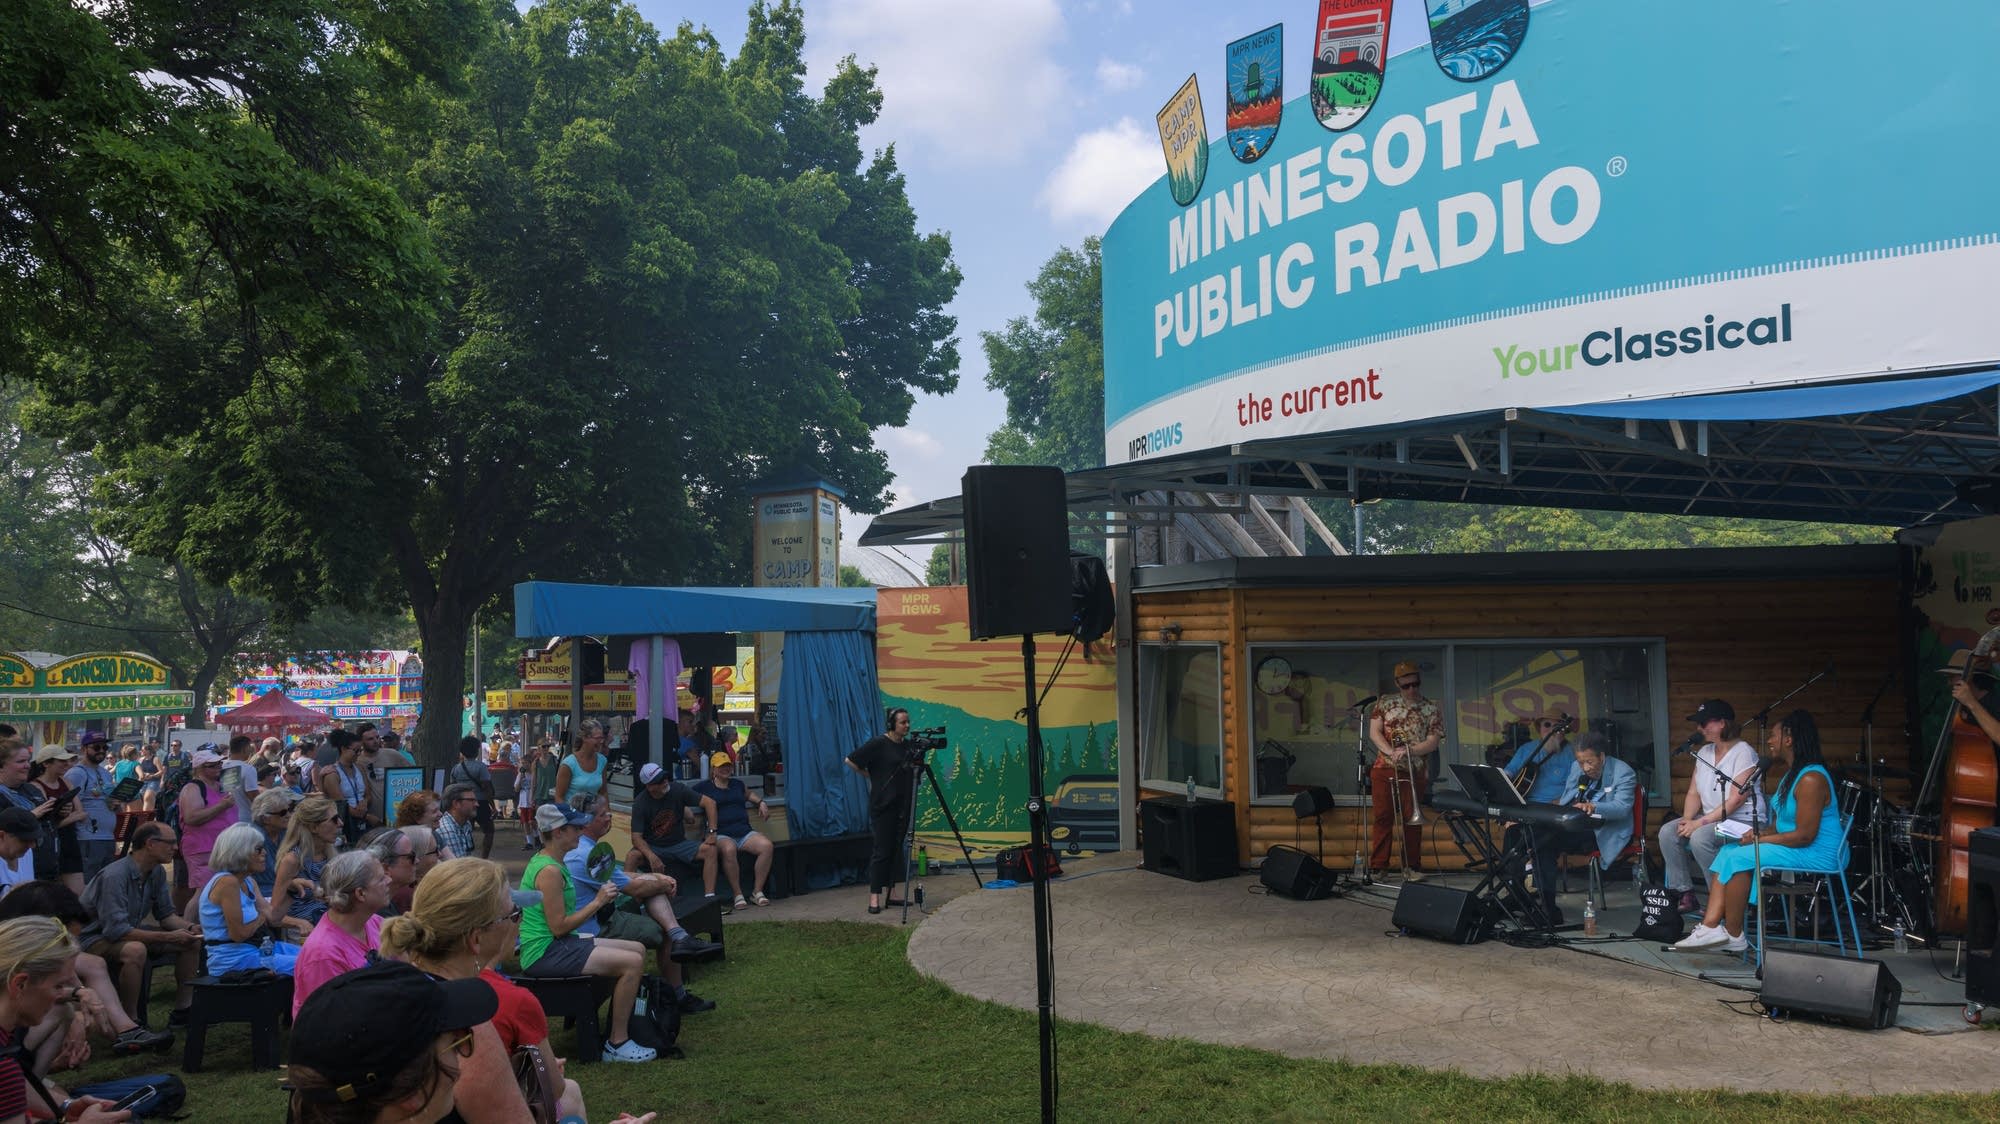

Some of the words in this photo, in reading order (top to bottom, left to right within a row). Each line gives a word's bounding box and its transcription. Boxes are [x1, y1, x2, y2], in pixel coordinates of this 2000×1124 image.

[1232, 42, 1249, 57] MPR
[1252, 32, 1275, 49] NEWS
[1163, 95, 1196, 140] CAMP
[1171, 121, 1198, 160] MPR
[1169, 79, 1540, 274] MINNESOTA
[1155, 242, 1315, 359] PUBLIC
[1335, 166, 1601, 295] RADIO
[1493, 303, 1792, 379] YourClassical
[1237, 393, 1273, 427] the
[1281, 369, 1383, 417] current
[1129, 421, 1183, 461] MPRnews
[773, 501, 803, 509] MINNESOTA
[772, 537, 803, 545] WELCOME
[764, 559, 811, 579] CAMP
[902, 593, 930, 604] MPR
[902, 604, 941, 615] news
[61, 657, 118, 685] PONCHO
[120, 658, 154, 683] DOGS
[528, 663, 570, 678] Sausage
[86, 696, 134, 710] CORN
[141, 695, 183, 708] DOGS
[336, 706, 358, 716] FRIED
[360, 706, 383, 715] OREOS
[390, 777, 420, 787] CAMP
